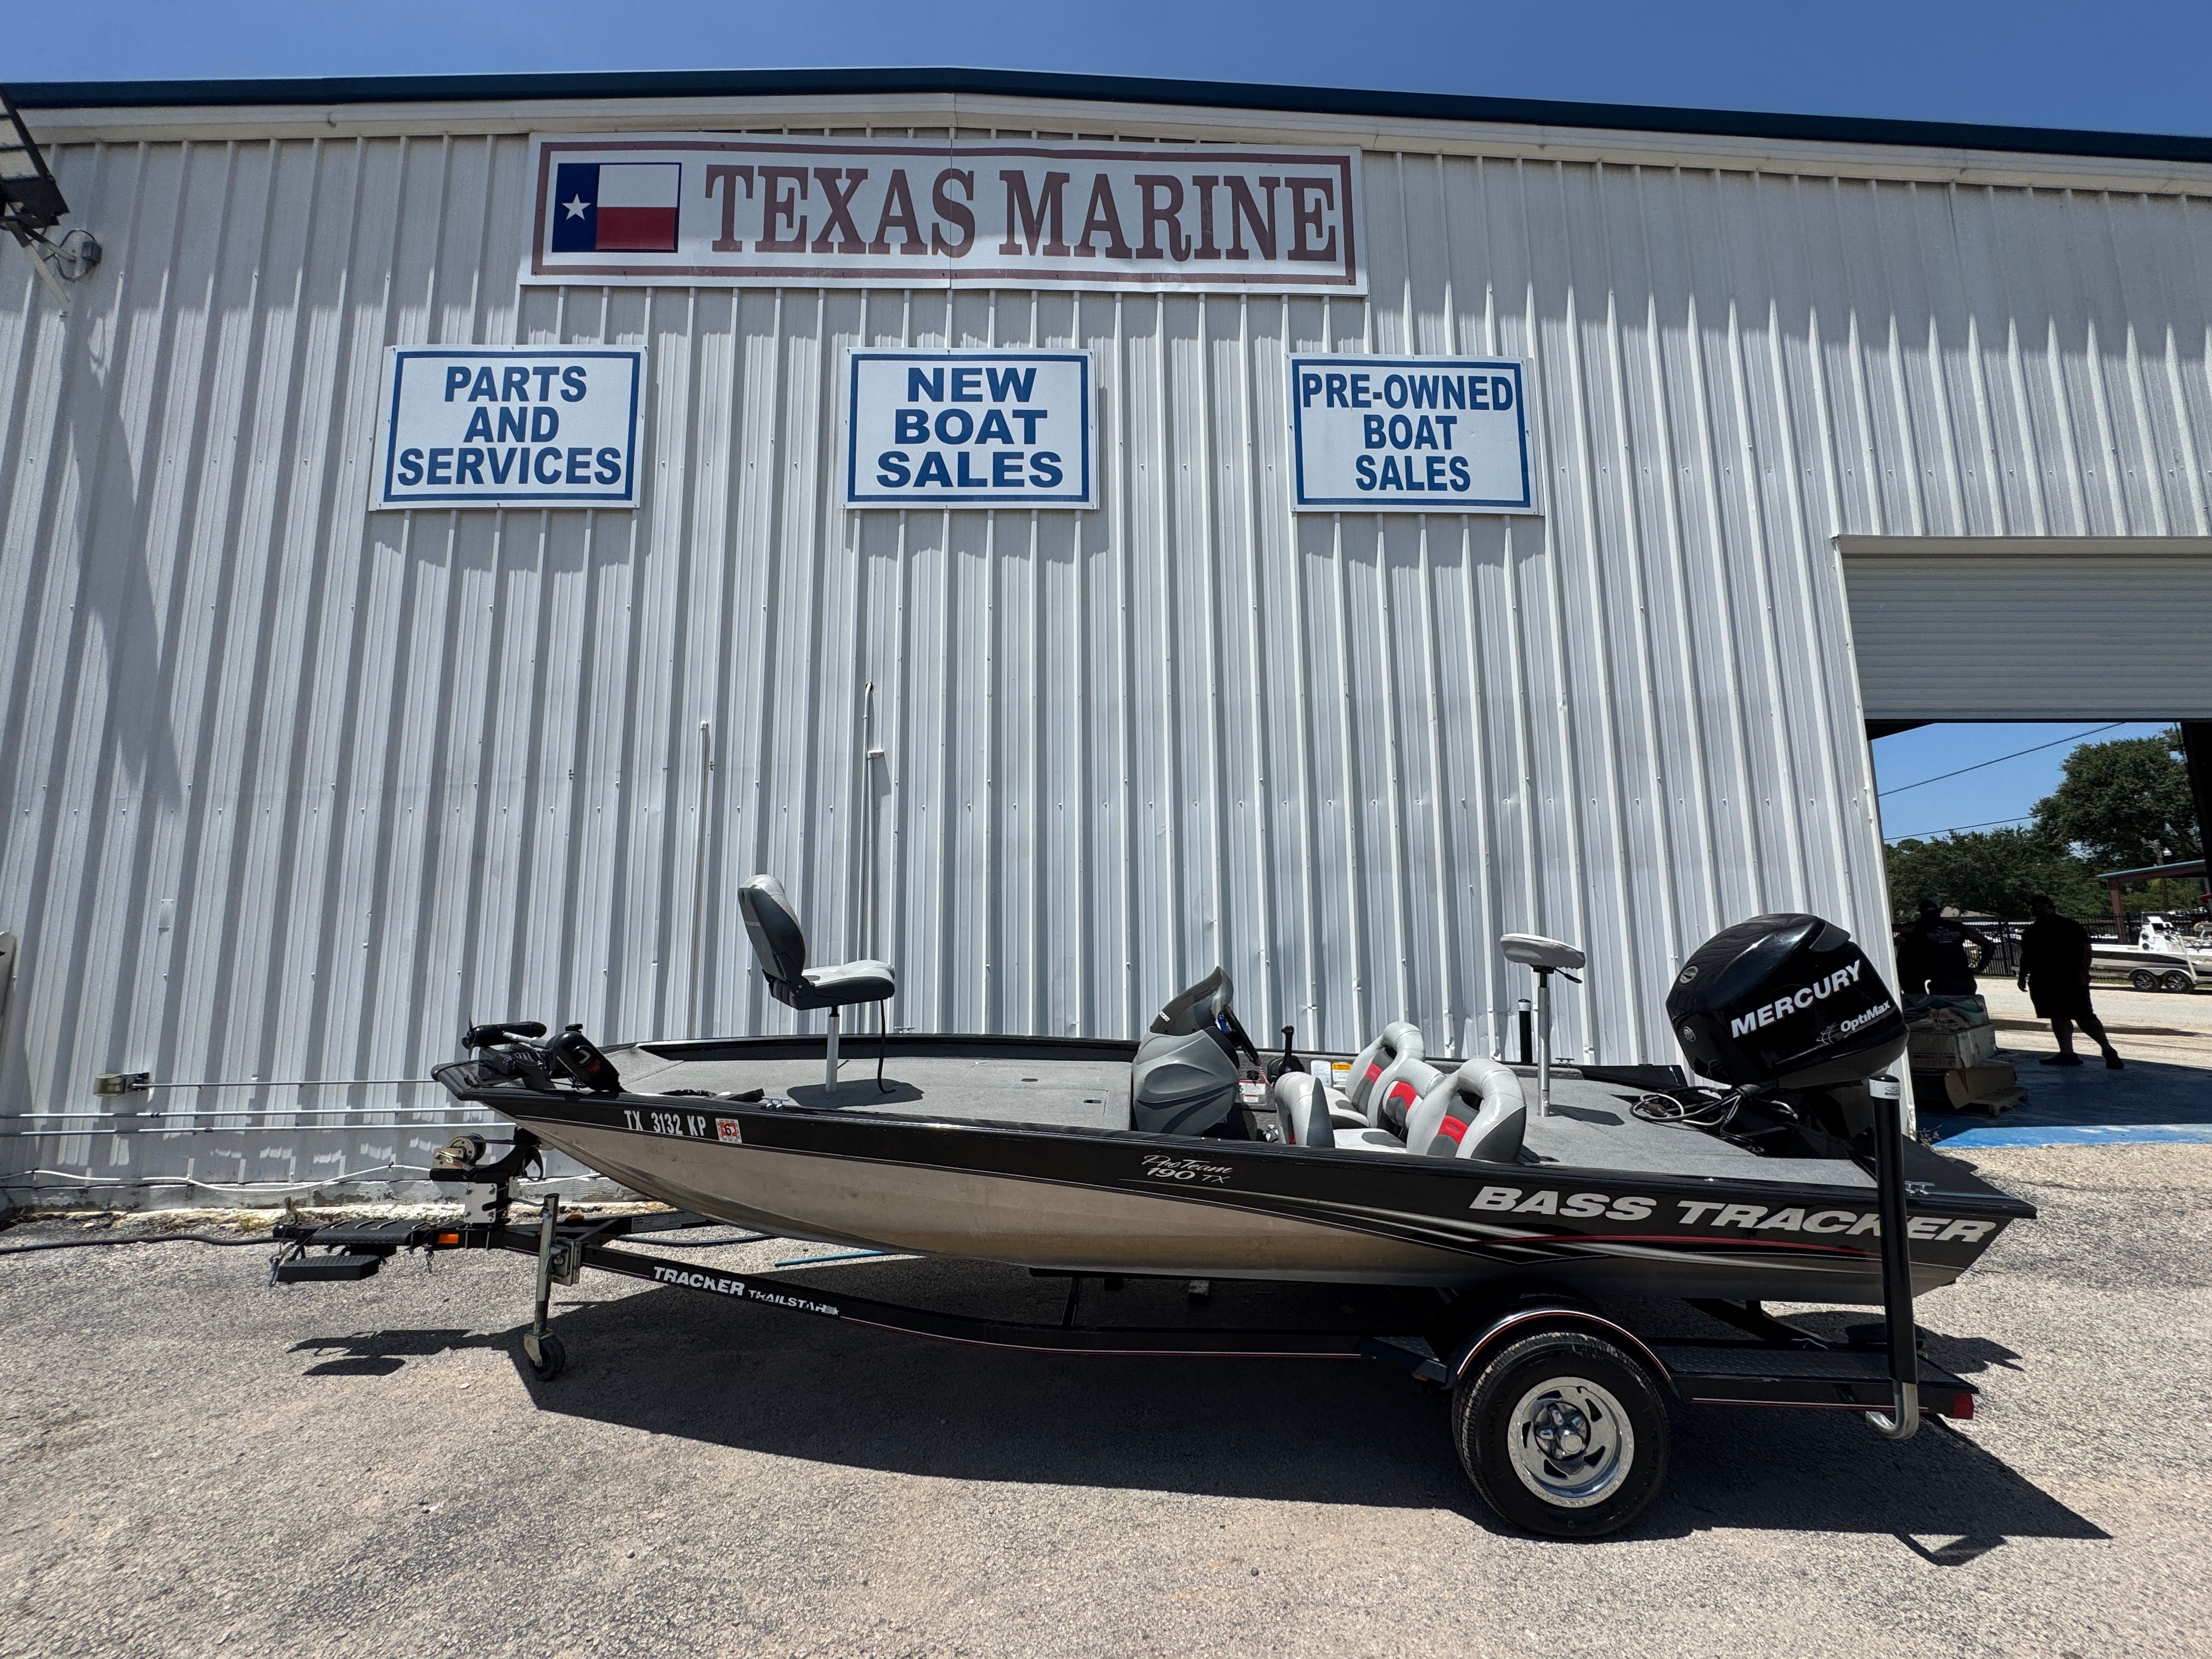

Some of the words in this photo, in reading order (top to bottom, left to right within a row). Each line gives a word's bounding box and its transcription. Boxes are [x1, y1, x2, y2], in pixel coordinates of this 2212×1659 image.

[705, 164, 975, 258] TEXAS
[998, 169, 1337, 262] MARINE
[444, 365, 587, 403] PARTS
[907, 367, 1037, 403] NEW
[1302, 373, 1514, 411] PRE-OWNED
[462, 406, 560, 443] AND
[894, 408, 1048, 445] BOAT
[1363, 414, 1458, 450] BOAT
[397, 447, 622, 486] SERVICES
[876, 450, 1064, 488] SALES
[1355, 454, 1471, 493] SALES
[1730, 958, 1862, 1039] MERCURY
[624, 1110, 644, 1132] TX
[651, 1112, 684, 1136] 3132
[686, 1115, 707, 1137] KP
[1146, 1167, 1196, 1180] 190
[1201, 1174, 1231, 1184] TX
[1468, 1186, 1658, 1221] BASS
[653, 1266, 746, 1296] TRACKER
